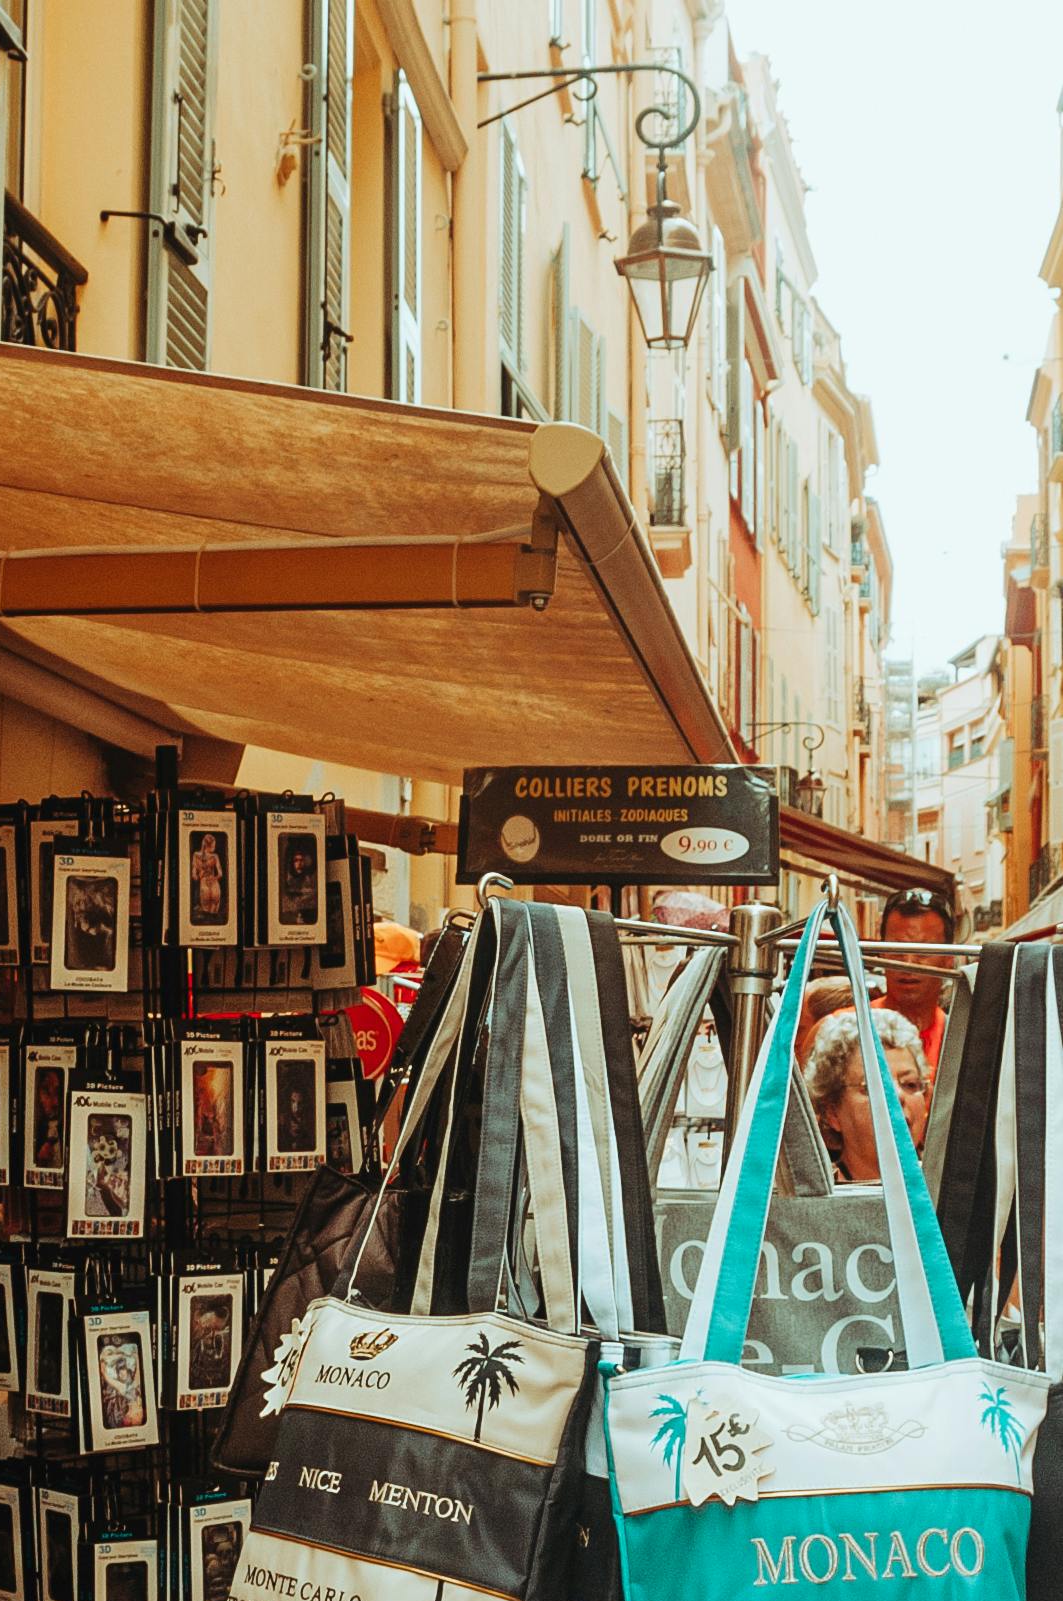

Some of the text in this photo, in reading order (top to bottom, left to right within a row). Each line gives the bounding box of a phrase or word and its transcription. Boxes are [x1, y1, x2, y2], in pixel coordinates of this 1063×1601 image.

[514, 775, 729, 799] COLLIERS PRENOMS
[553, 808, 689, 824] INITIALES ZODIAQUES
[617, 834, 634, 843] OR
[97, 1083, 124, 1091] Picture
[88, 1316, 102, 1326] 3D
[315, 1364, 391, 1390] MONACO
[692, 1413, 751, 1478] 15€
[298, 1466, 343, 1494] NICE
[369, 1479, 475, 1526] MENTON
[194, 1507, 207, 1517] 3D
[98, 1544, 111, 1554] 3D
[750, 1526, 986, 1588] MONACO
[244, 1564, 298, 1598] MONTE
